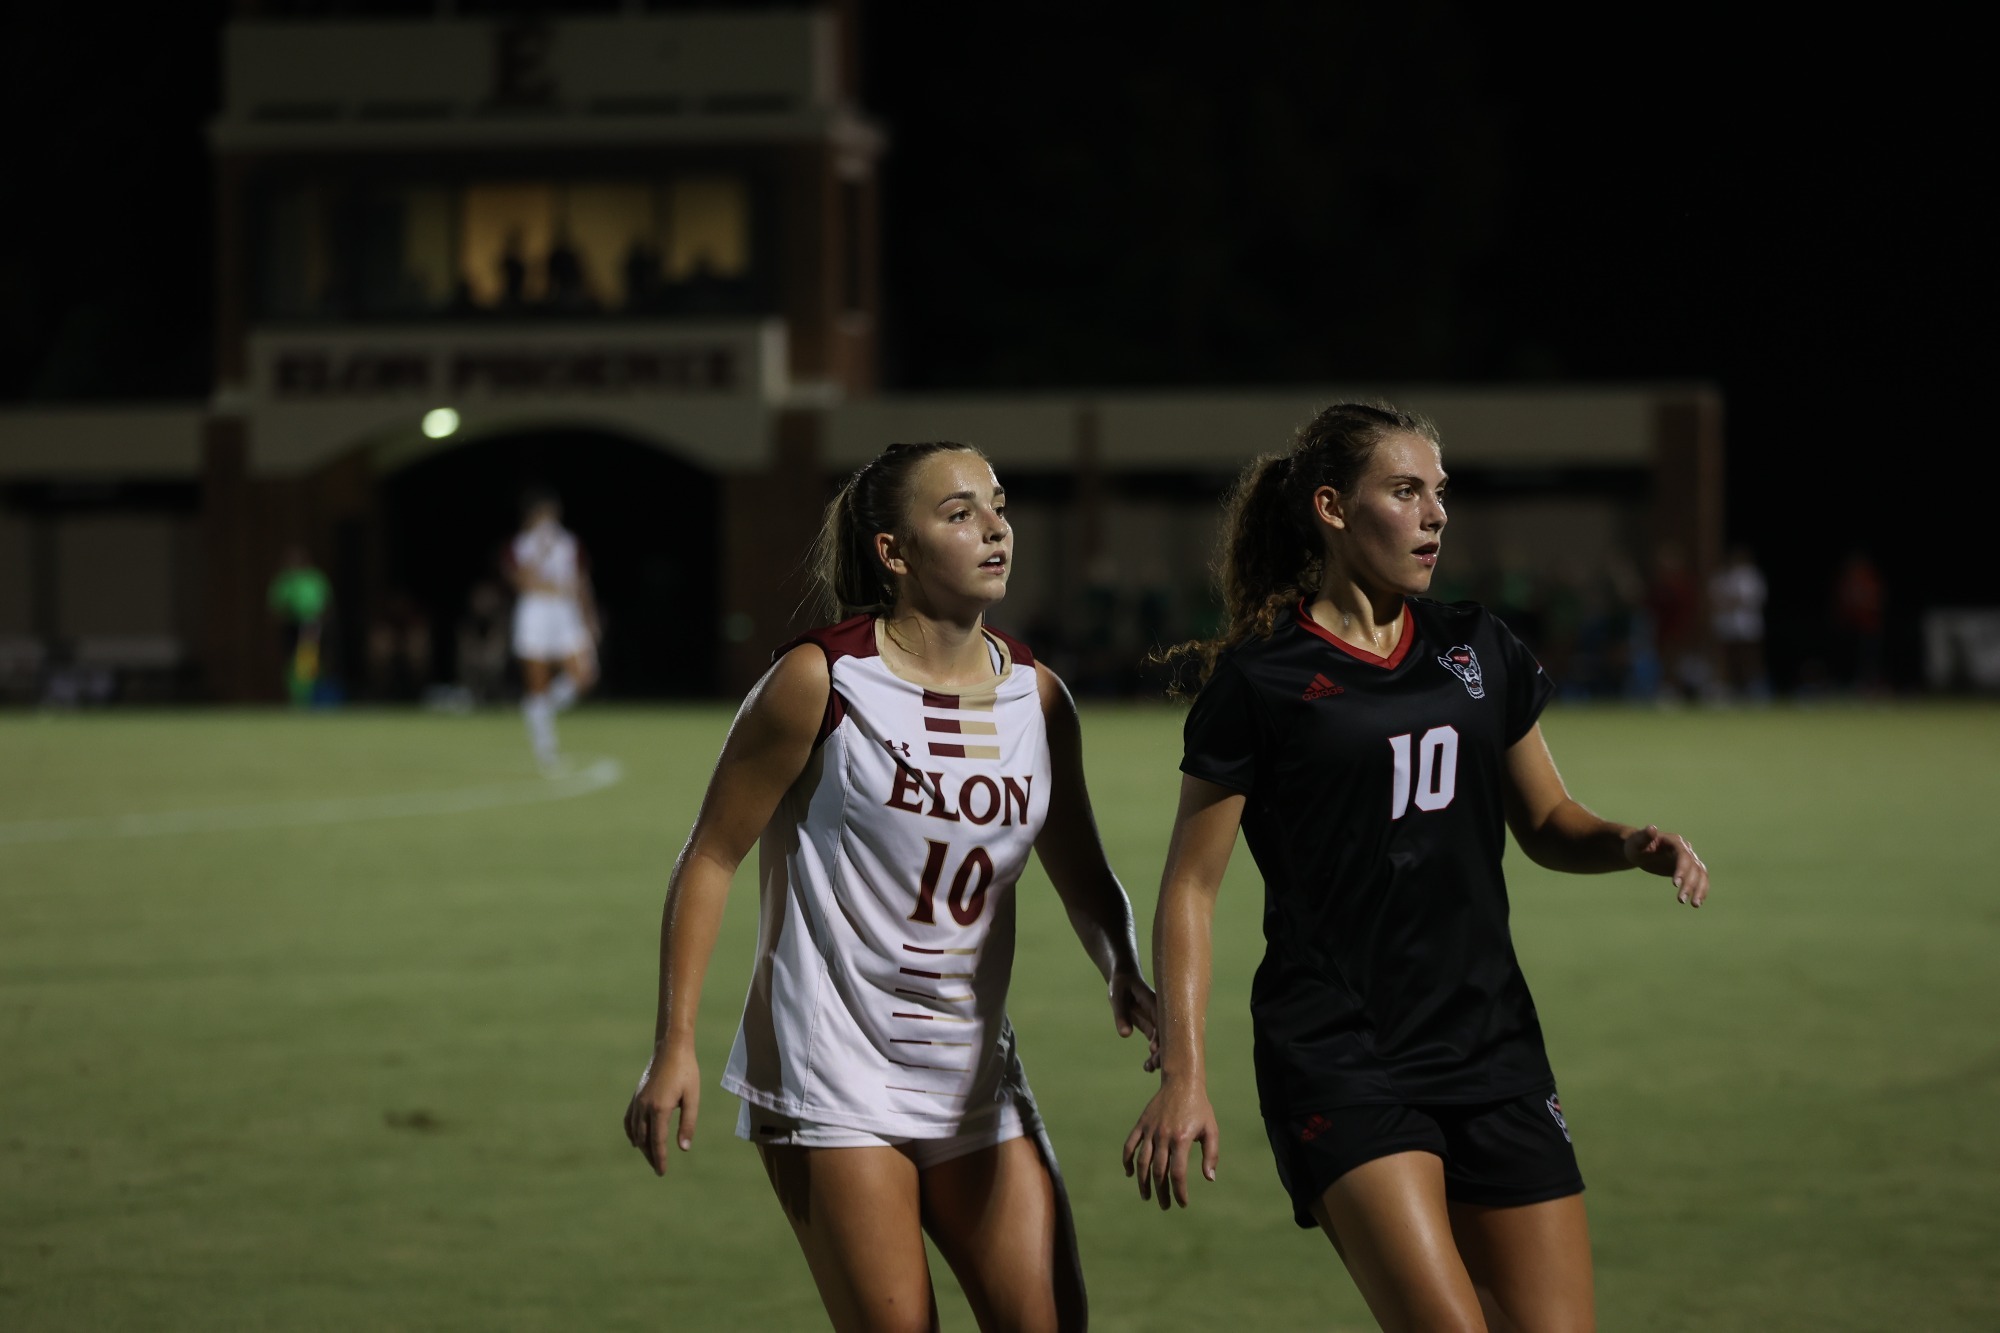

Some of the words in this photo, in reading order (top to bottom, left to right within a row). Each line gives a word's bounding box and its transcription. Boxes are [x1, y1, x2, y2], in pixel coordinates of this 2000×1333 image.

[1302, 685, 1345, 701] adidas
[884, 764, 1033, 826] ELON
[1387, 724, 1459, 820] 10
[906, 837, 994, 927] 10
